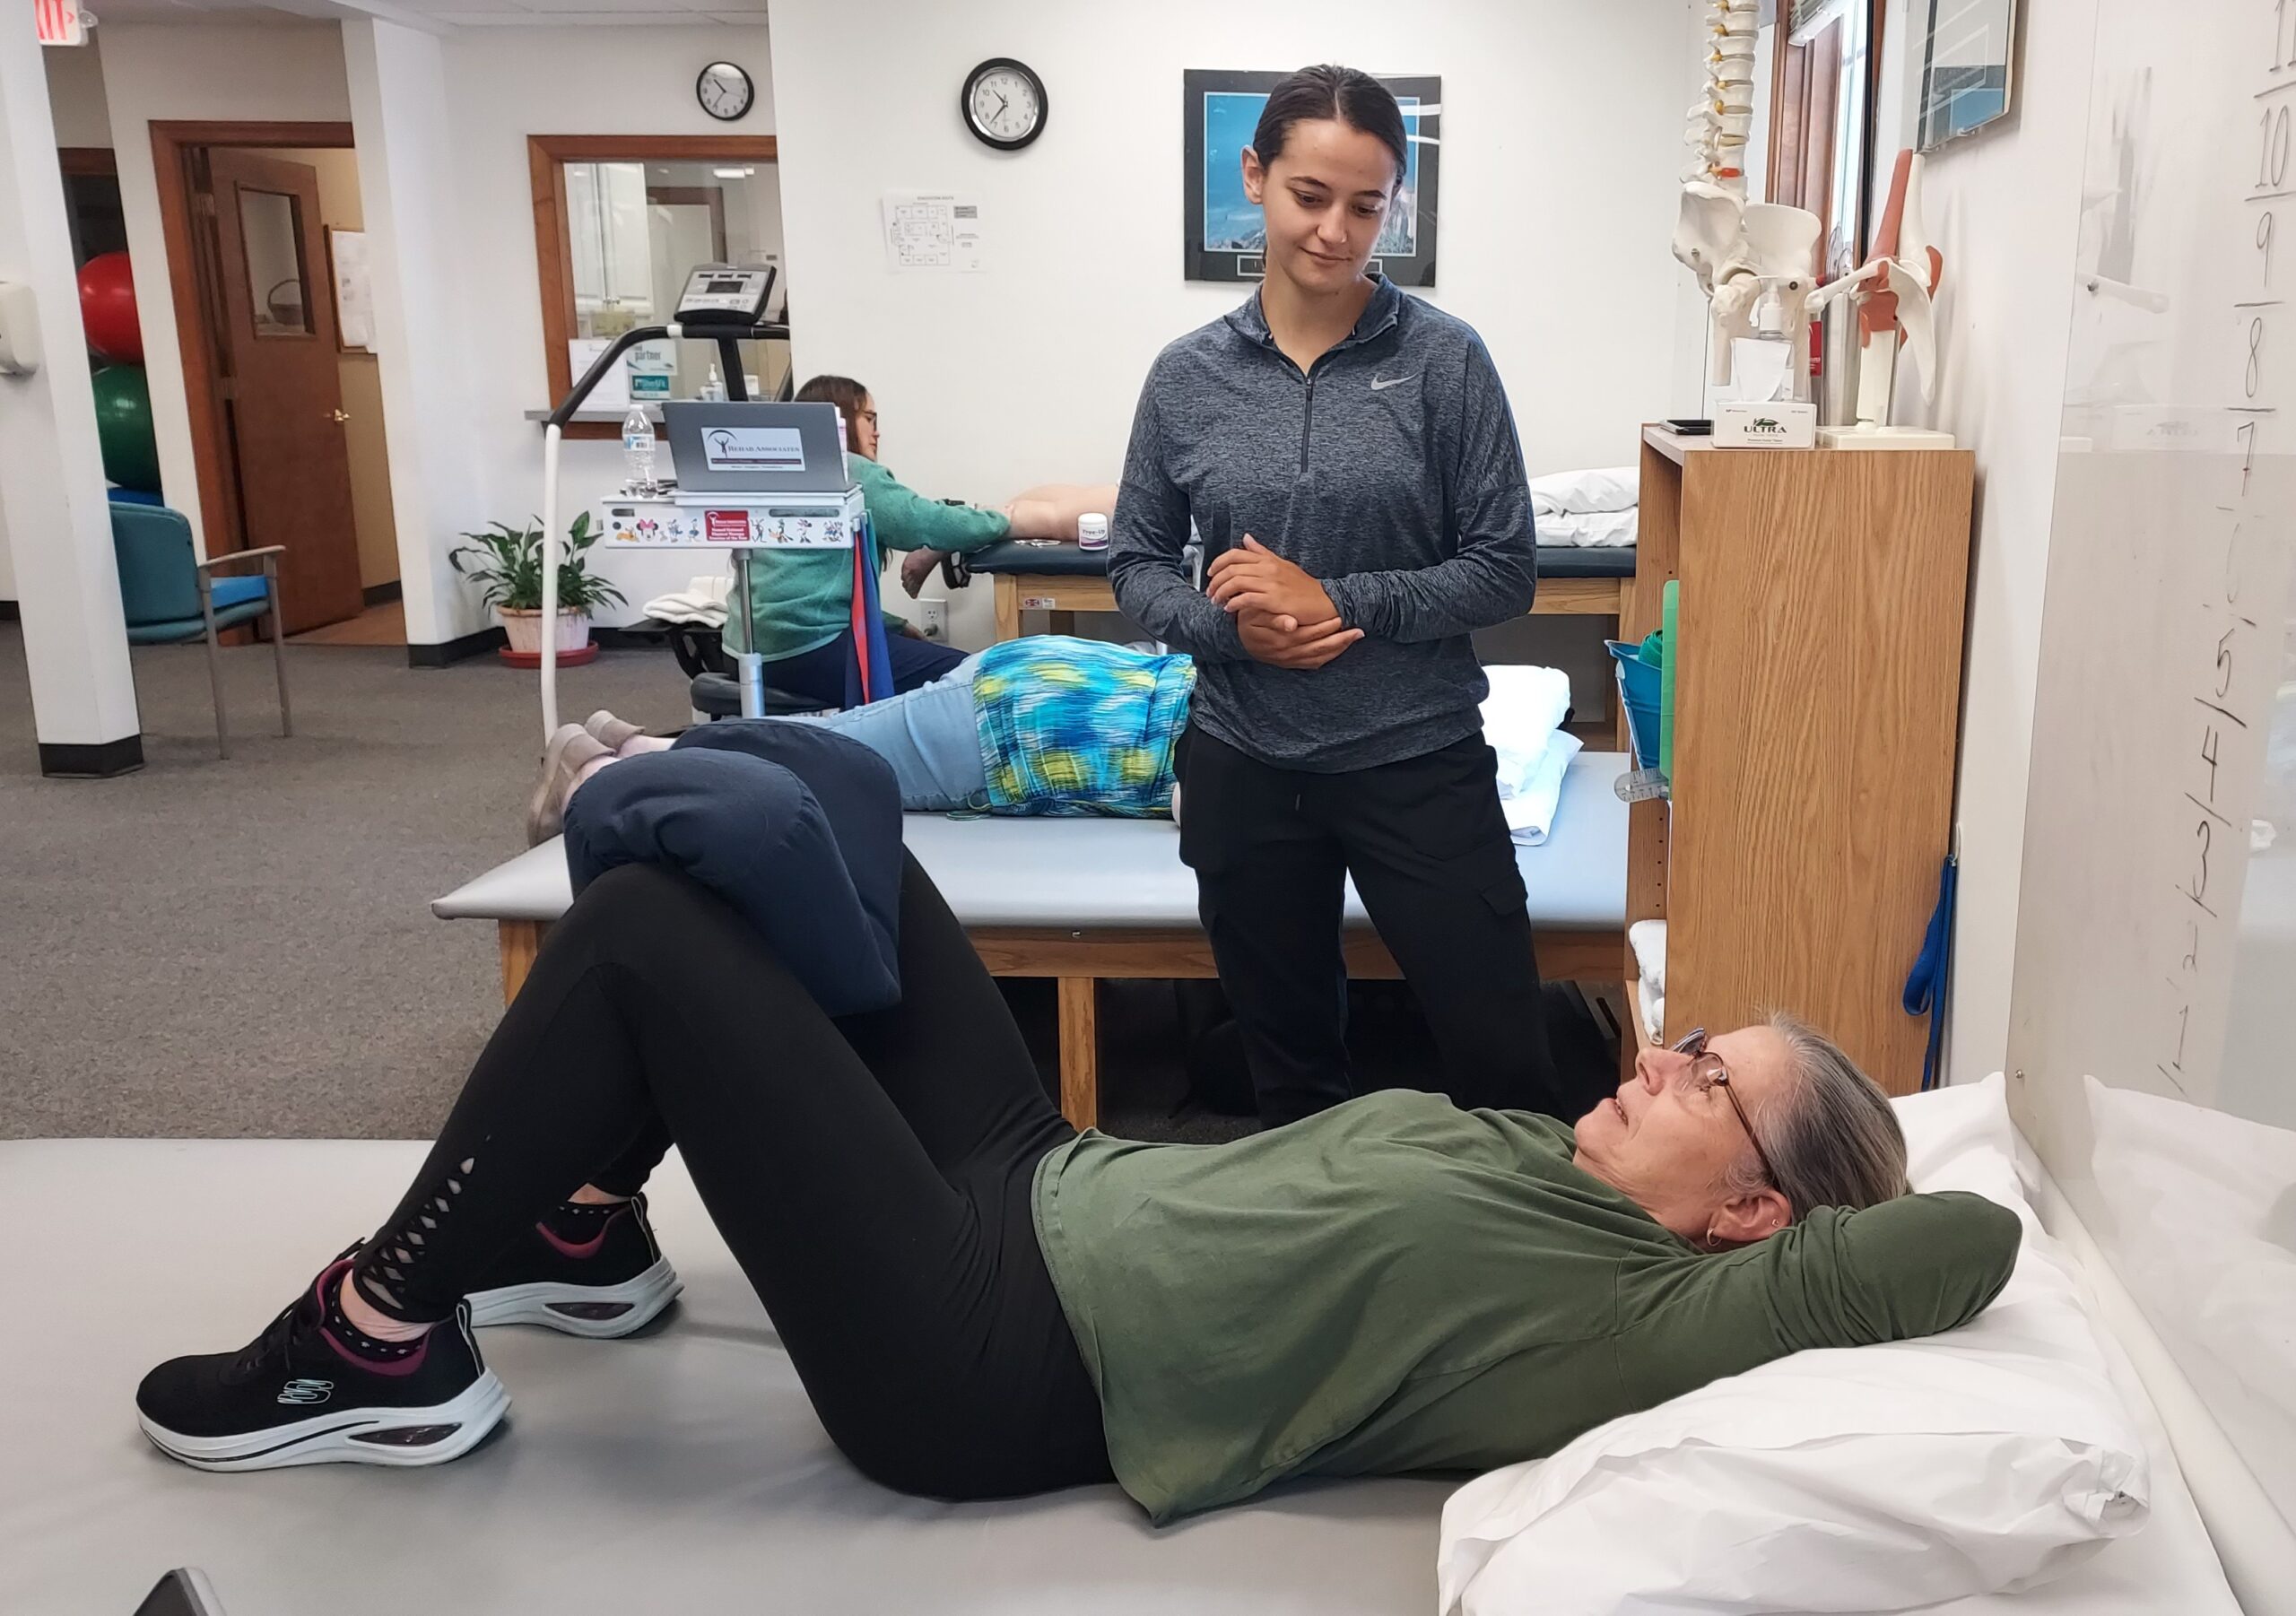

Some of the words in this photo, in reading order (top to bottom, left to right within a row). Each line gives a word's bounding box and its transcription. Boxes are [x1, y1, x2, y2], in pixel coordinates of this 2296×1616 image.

[2255, 104, 2289, 188] 10
[2256, 211, 2273, 288] 9
[2245, 317, 2263, 398] 8
[1744, 425, 1787, 433] ULTRA
[2237, 421, 2255, 496] 7
[2215, 628, 2235, 698] 5
[2202, 725, 2218, 803] 4
[2193, 820, 2211, 899] 3
